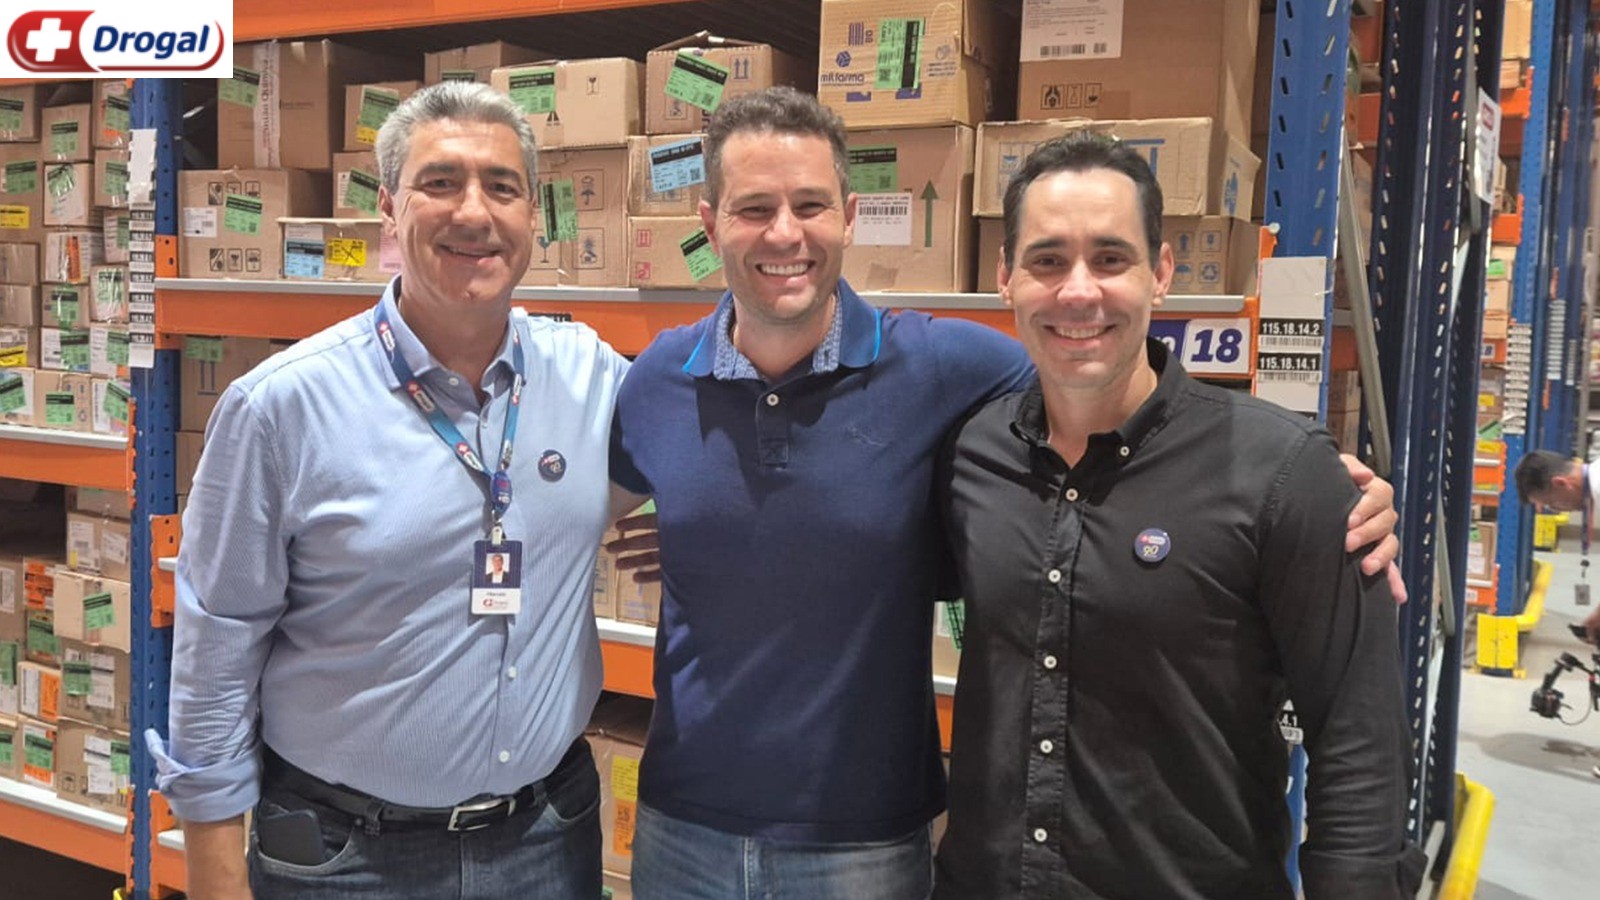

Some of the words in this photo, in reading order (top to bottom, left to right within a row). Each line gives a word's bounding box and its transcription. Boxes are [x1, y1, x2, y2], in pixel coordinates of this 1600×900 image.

[1261, 321, 1320, 335] 115.18.14.2
[1191, 328, 1243, 363] 18
[1259, 356, 1317, 370] 115.18.14.1
